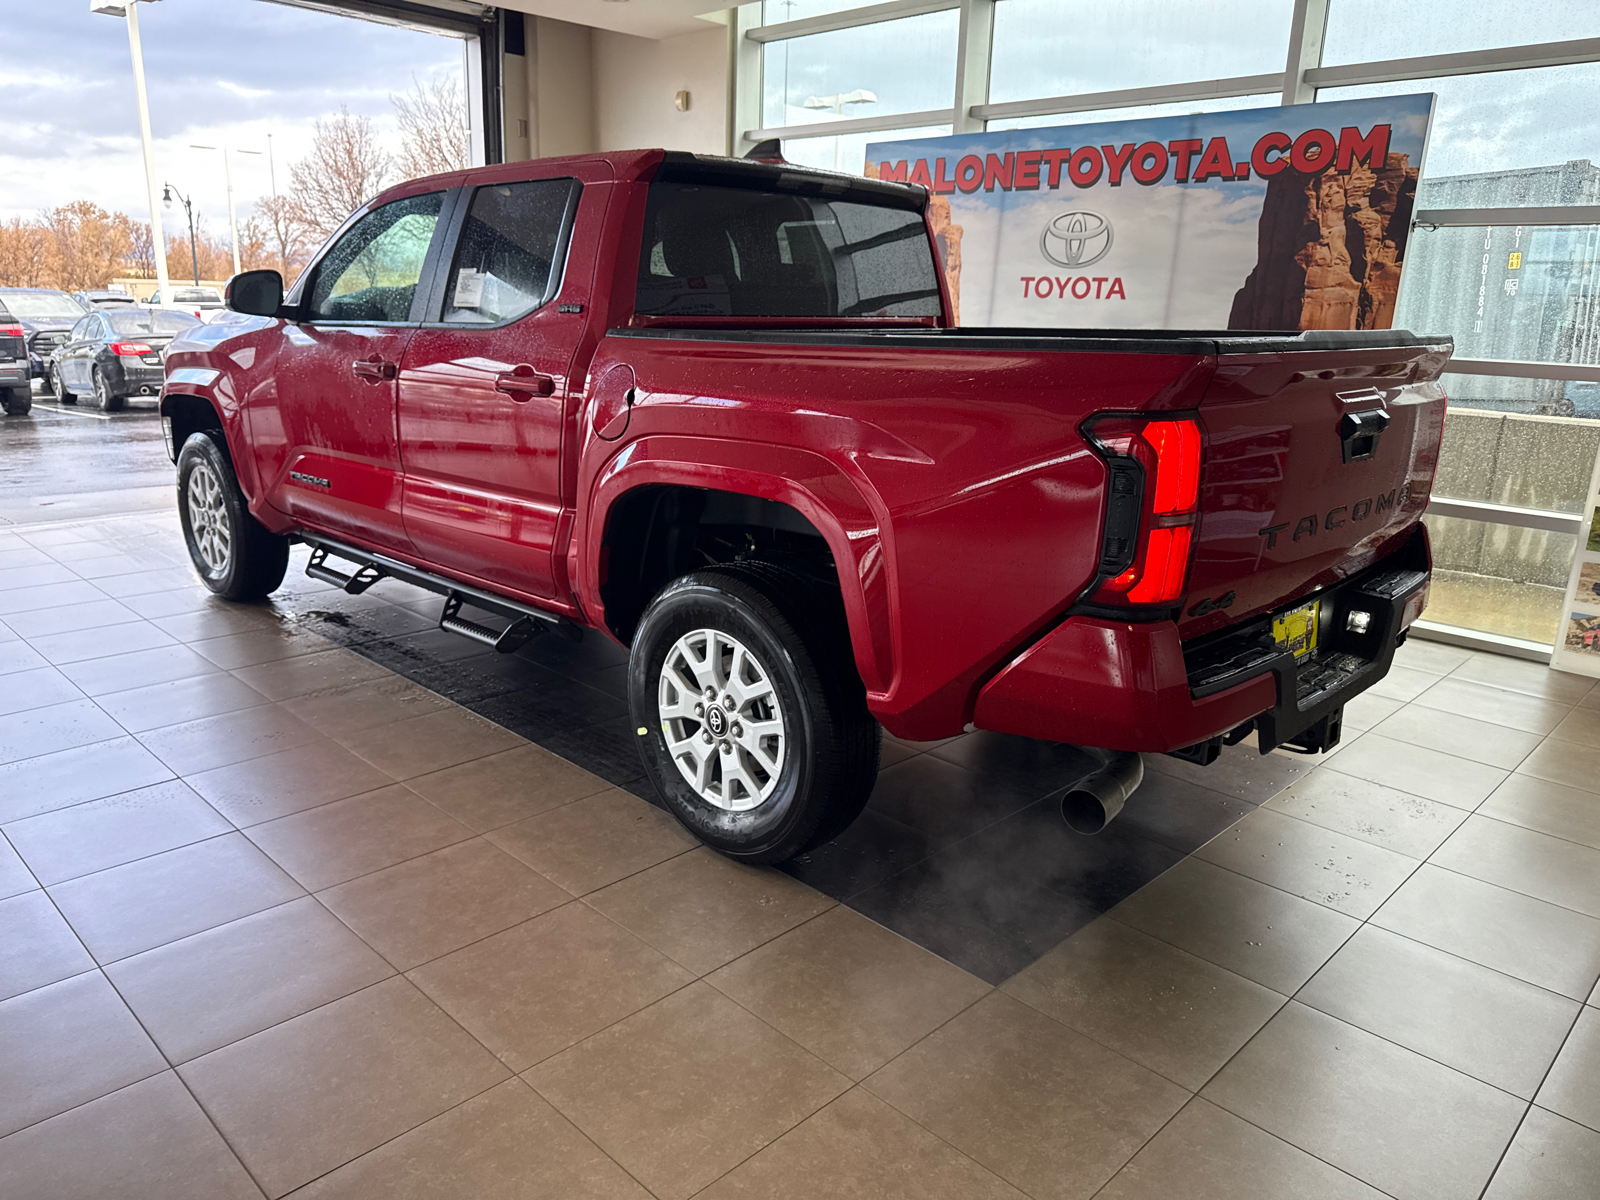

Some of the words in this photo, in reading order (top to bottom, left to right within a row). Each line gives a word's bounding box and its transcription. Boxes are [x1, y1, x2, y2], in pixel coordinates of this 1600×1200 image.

[1020, 276, 1126, 301] TOYOTA
[289, 470, 331, 488] TACOMA
[1259, 483, 1411, 549] TACOMA
